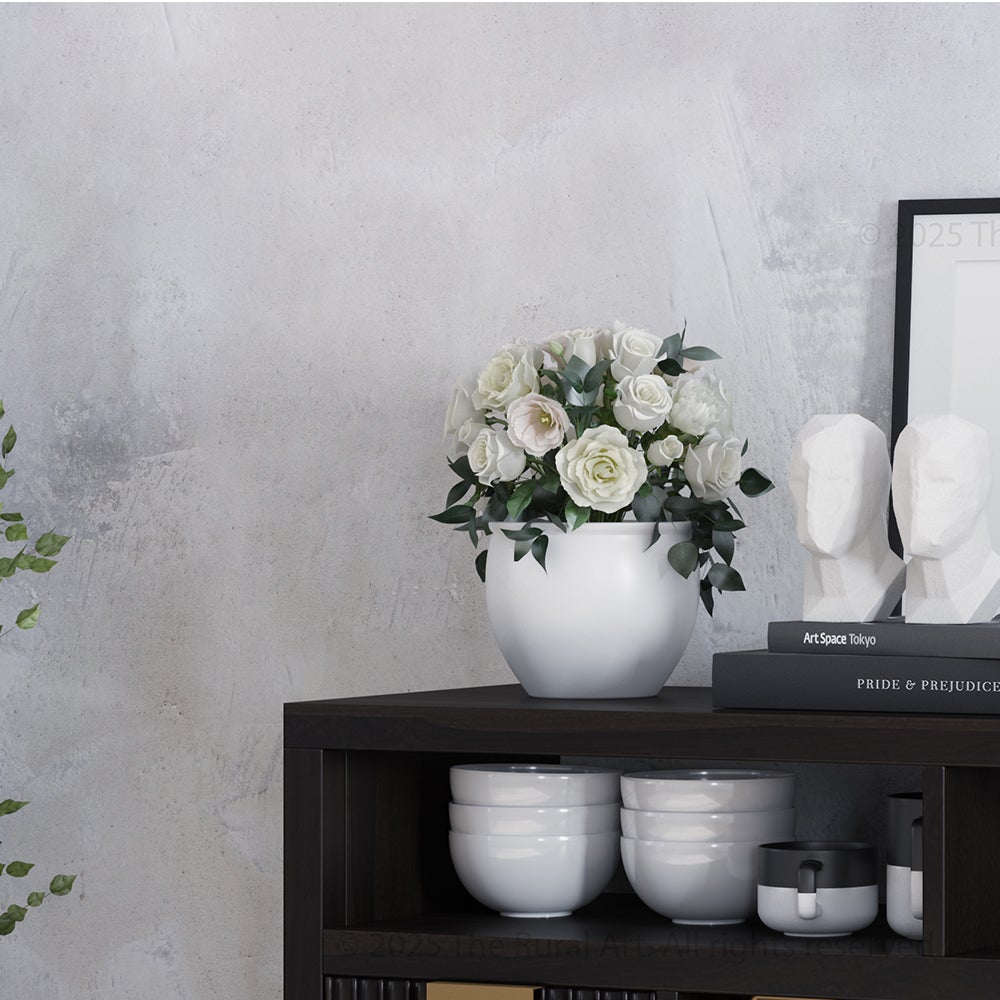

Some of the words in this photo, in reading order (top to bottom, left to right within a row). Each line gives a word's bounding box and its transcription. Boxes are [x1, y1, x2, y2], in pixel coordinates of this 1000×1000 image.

[803, 632, 819, 644] Art
[820, 632, 847, 646] Space
[849, 633, 876, 648] Tokyo
[857, 679, 900, 690] PRIDE
[905, 680, 916, 690] &
[921, 680, 1000, 692] PREJUDICE
